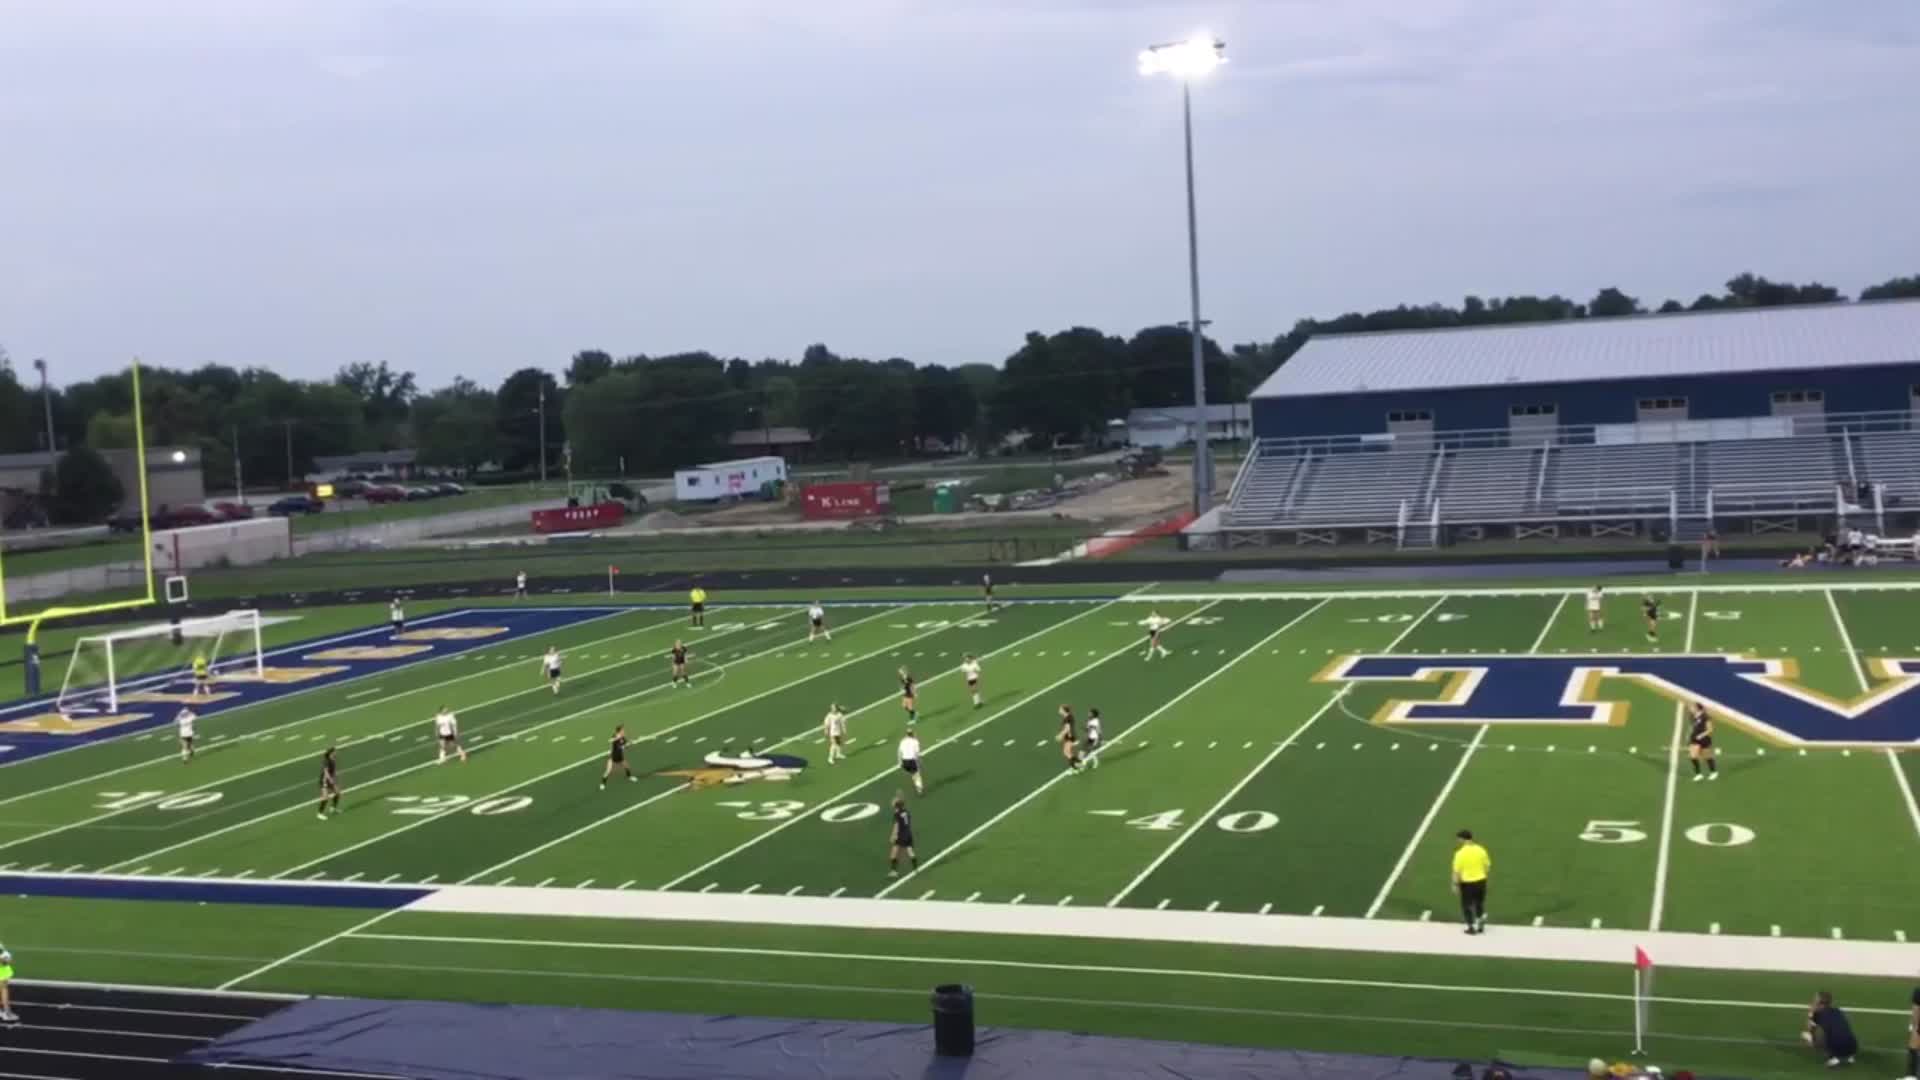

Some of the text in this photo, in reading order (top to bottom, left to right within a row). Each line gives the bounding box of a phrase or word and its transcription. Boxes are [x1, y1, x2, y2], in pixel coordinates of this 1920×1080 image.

[391, 795, 533, 814] 20
[736, 800, 880, 822] 30
[1125, 809, 1280, 832] 40
[1577, 820, 1756, 846] 50
